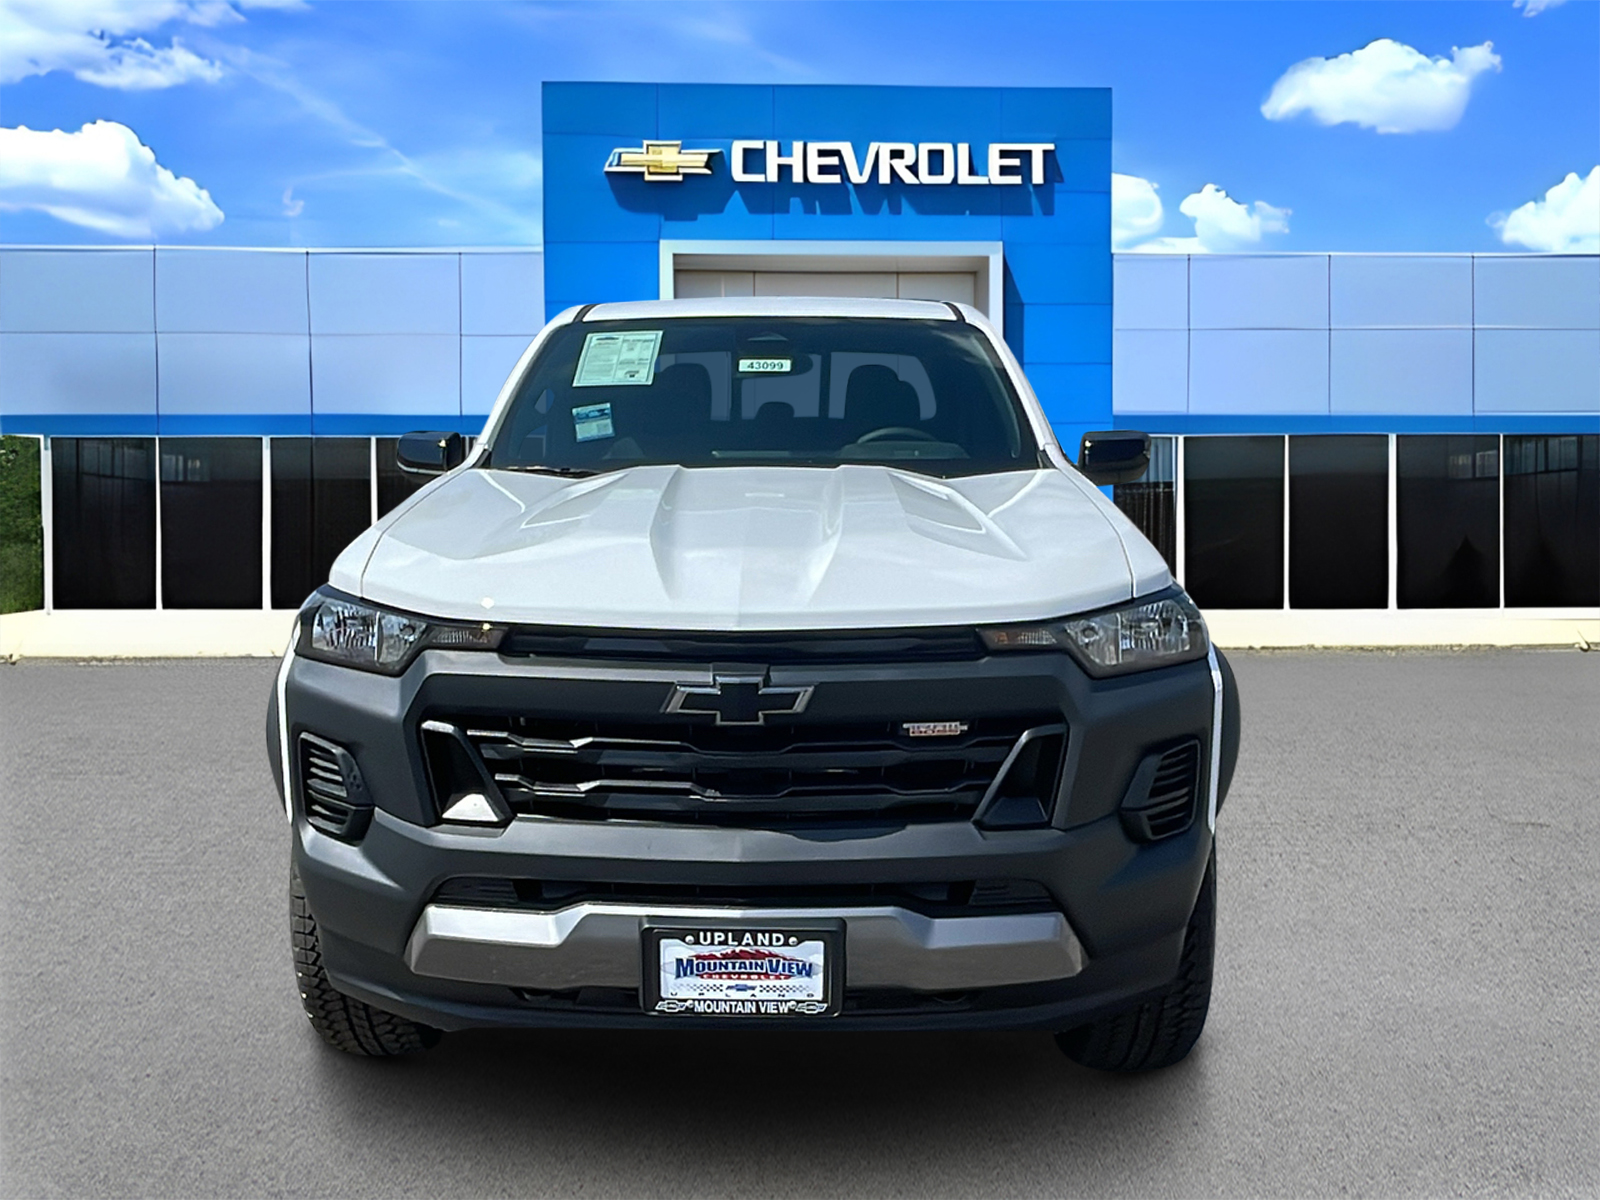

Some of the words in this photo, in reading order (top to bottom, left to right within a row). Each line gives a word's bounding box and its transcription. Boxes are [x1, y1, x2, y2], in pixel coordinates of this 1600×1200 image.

[730, 140, 1056, 185] CHEVROLET
[746, 361, 784, 370] 43099
[699, 931, 785, 946] UPLAND
[694, 1000, 757, 1014] MOUNTAIN
[758, 1001, 790, 1014] VIEW
